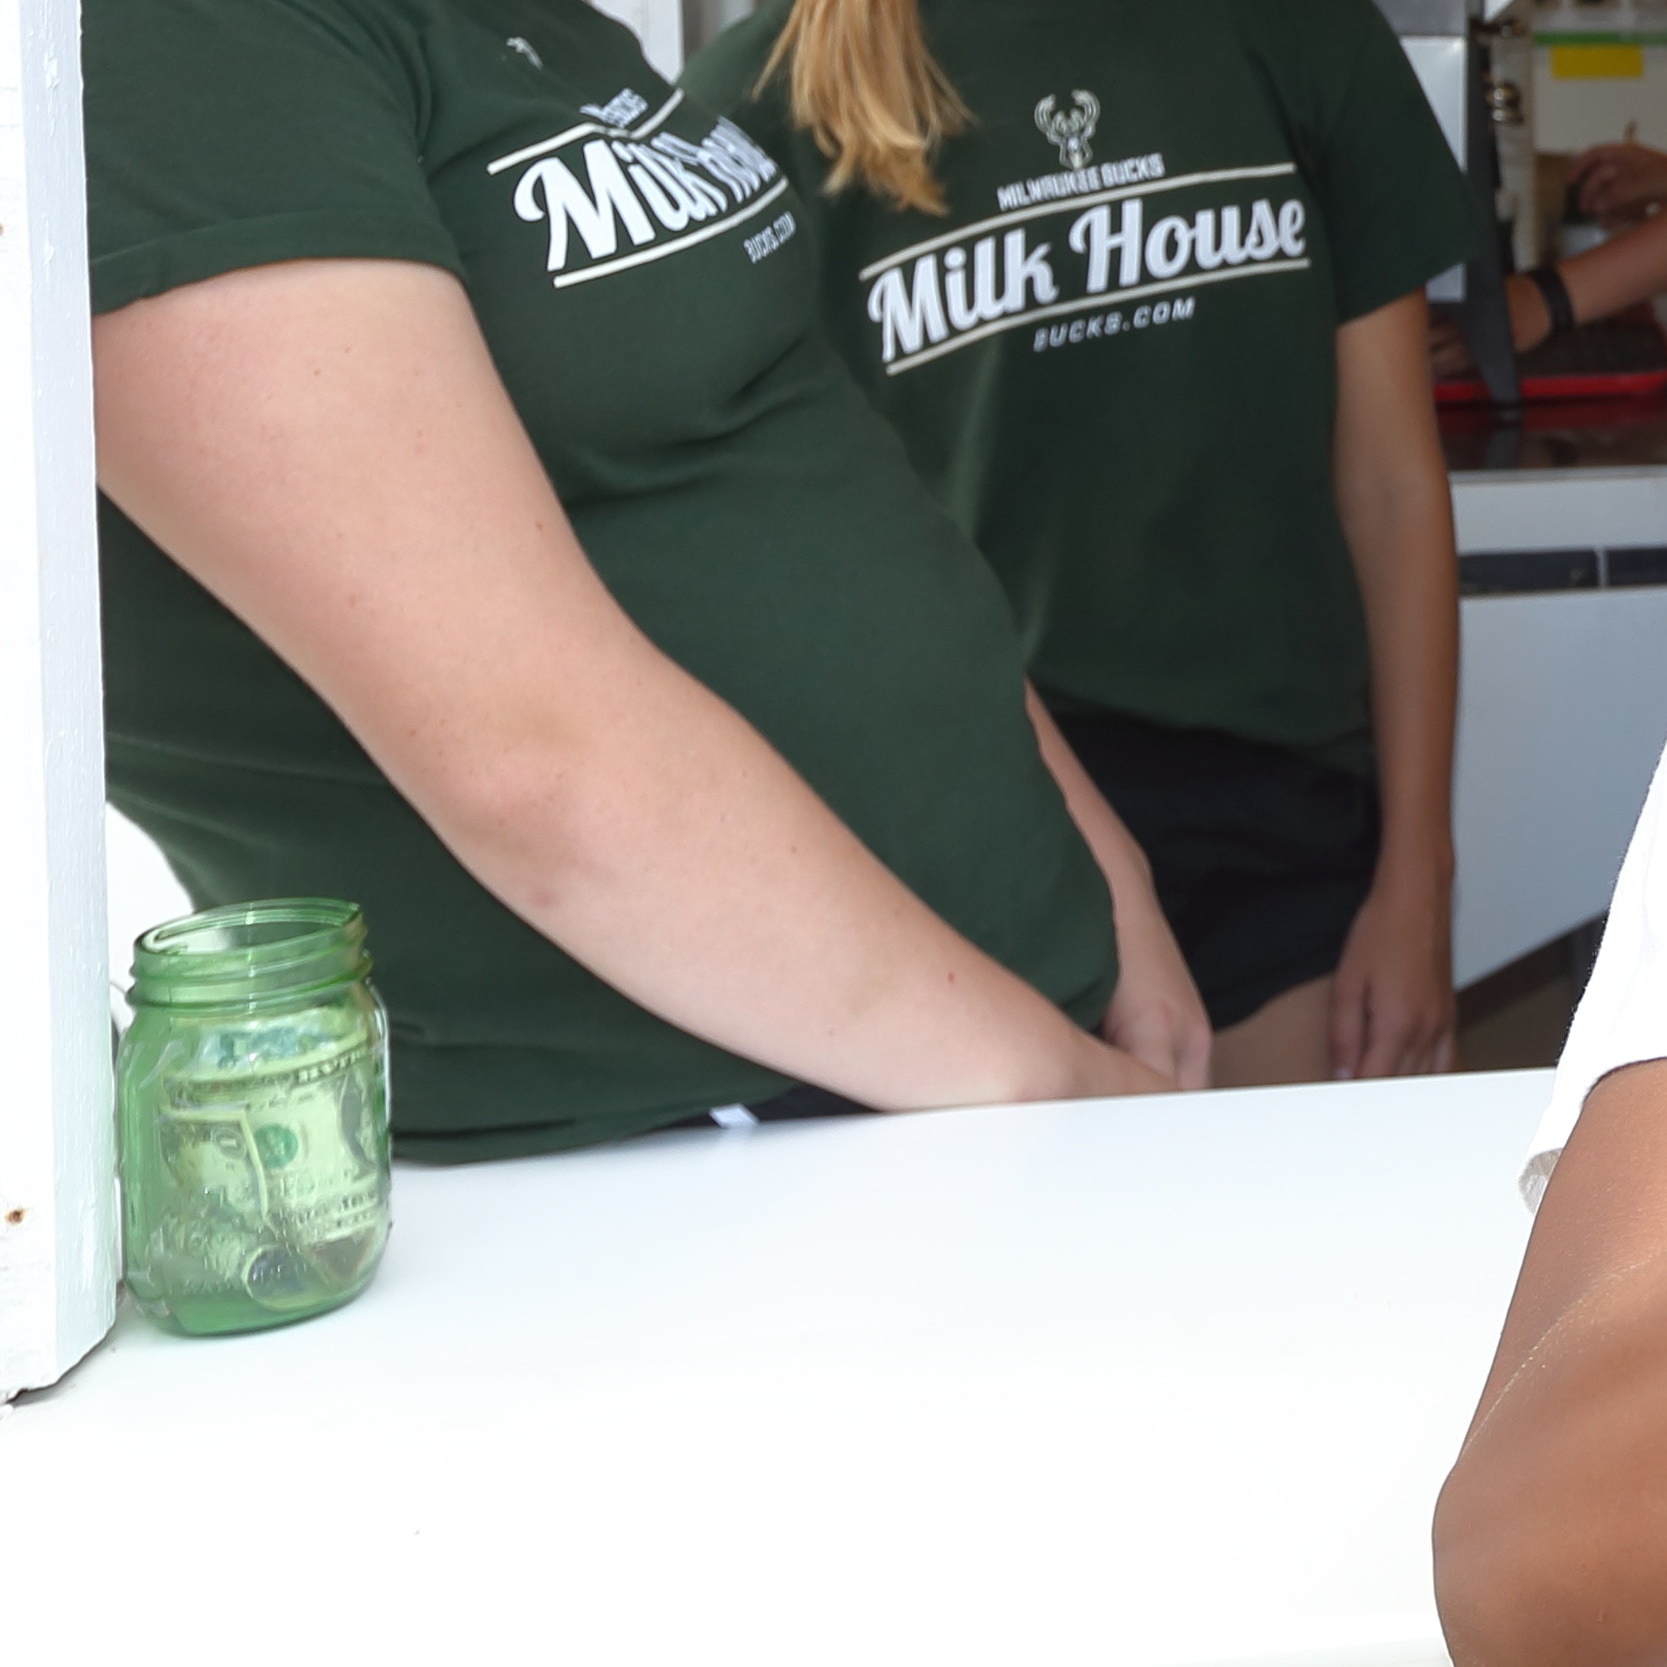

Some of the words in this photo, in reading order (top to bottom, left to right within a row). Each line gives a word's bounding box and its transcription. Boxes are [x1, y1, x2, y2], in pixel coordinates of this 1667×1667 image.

[997, 166, 1100, 211] MILWAUKEE
[1102, 152, 1166, 191] BUCKS
[867, 228, 1059, 364] Milk
[1068, 197, 1306, 294] House
[1033, 296, 1196, 352] BUCKS.COM
